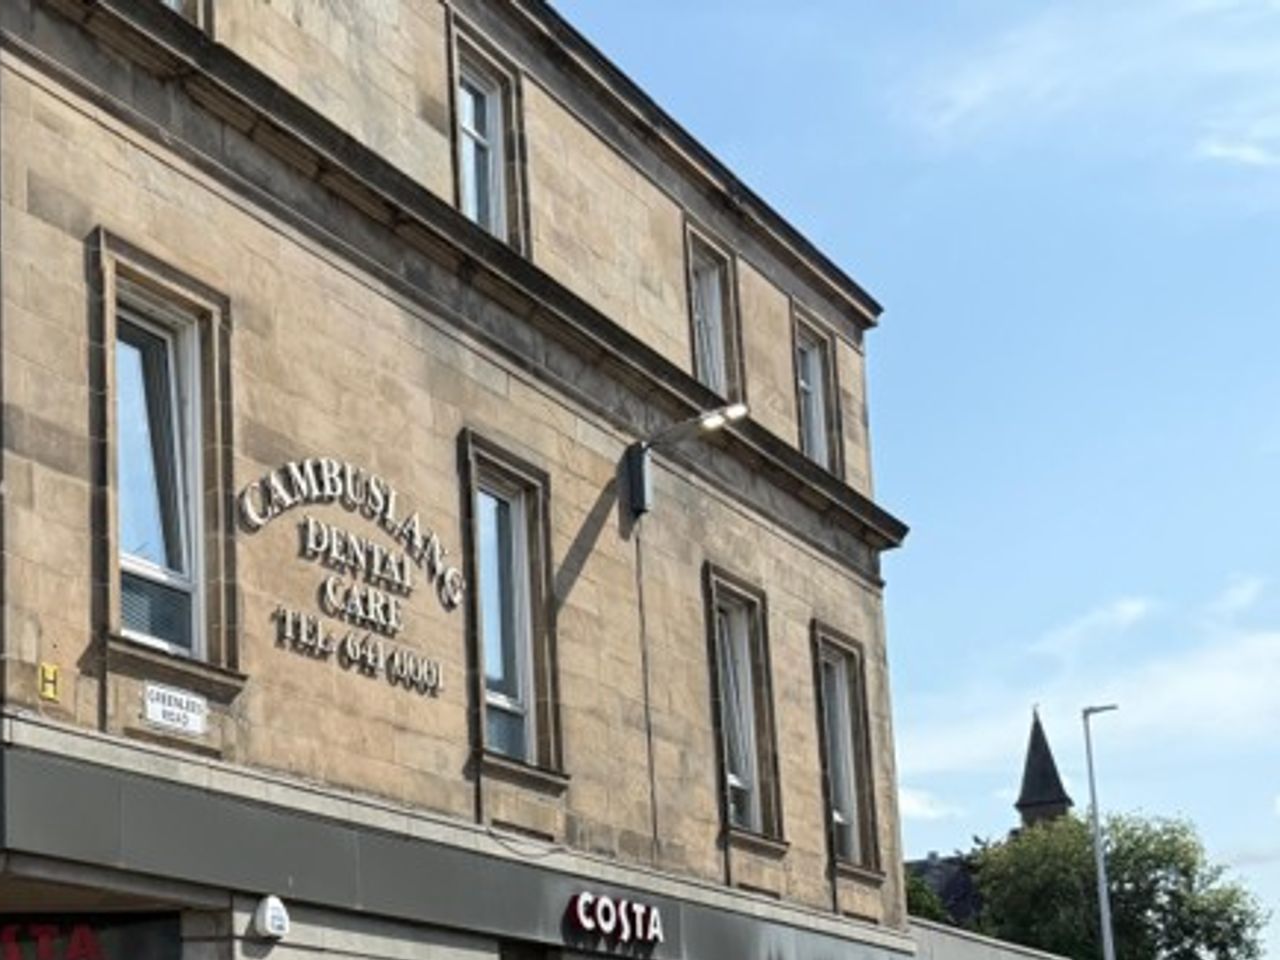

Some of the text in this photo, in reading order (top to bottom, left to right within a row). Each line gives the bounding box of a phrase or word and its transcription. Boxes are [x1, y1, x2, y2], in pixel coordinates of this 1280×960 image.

[239, 456, 467, 611] CAMBUSLANG
[299, 513, 414, 597] DENTAL
[320, 574, 404, 636] CARE
[41, 665, 57, 695] H
[161, 709, 189, 727] ROAD
[577, 891, 664, 943] COSTA
